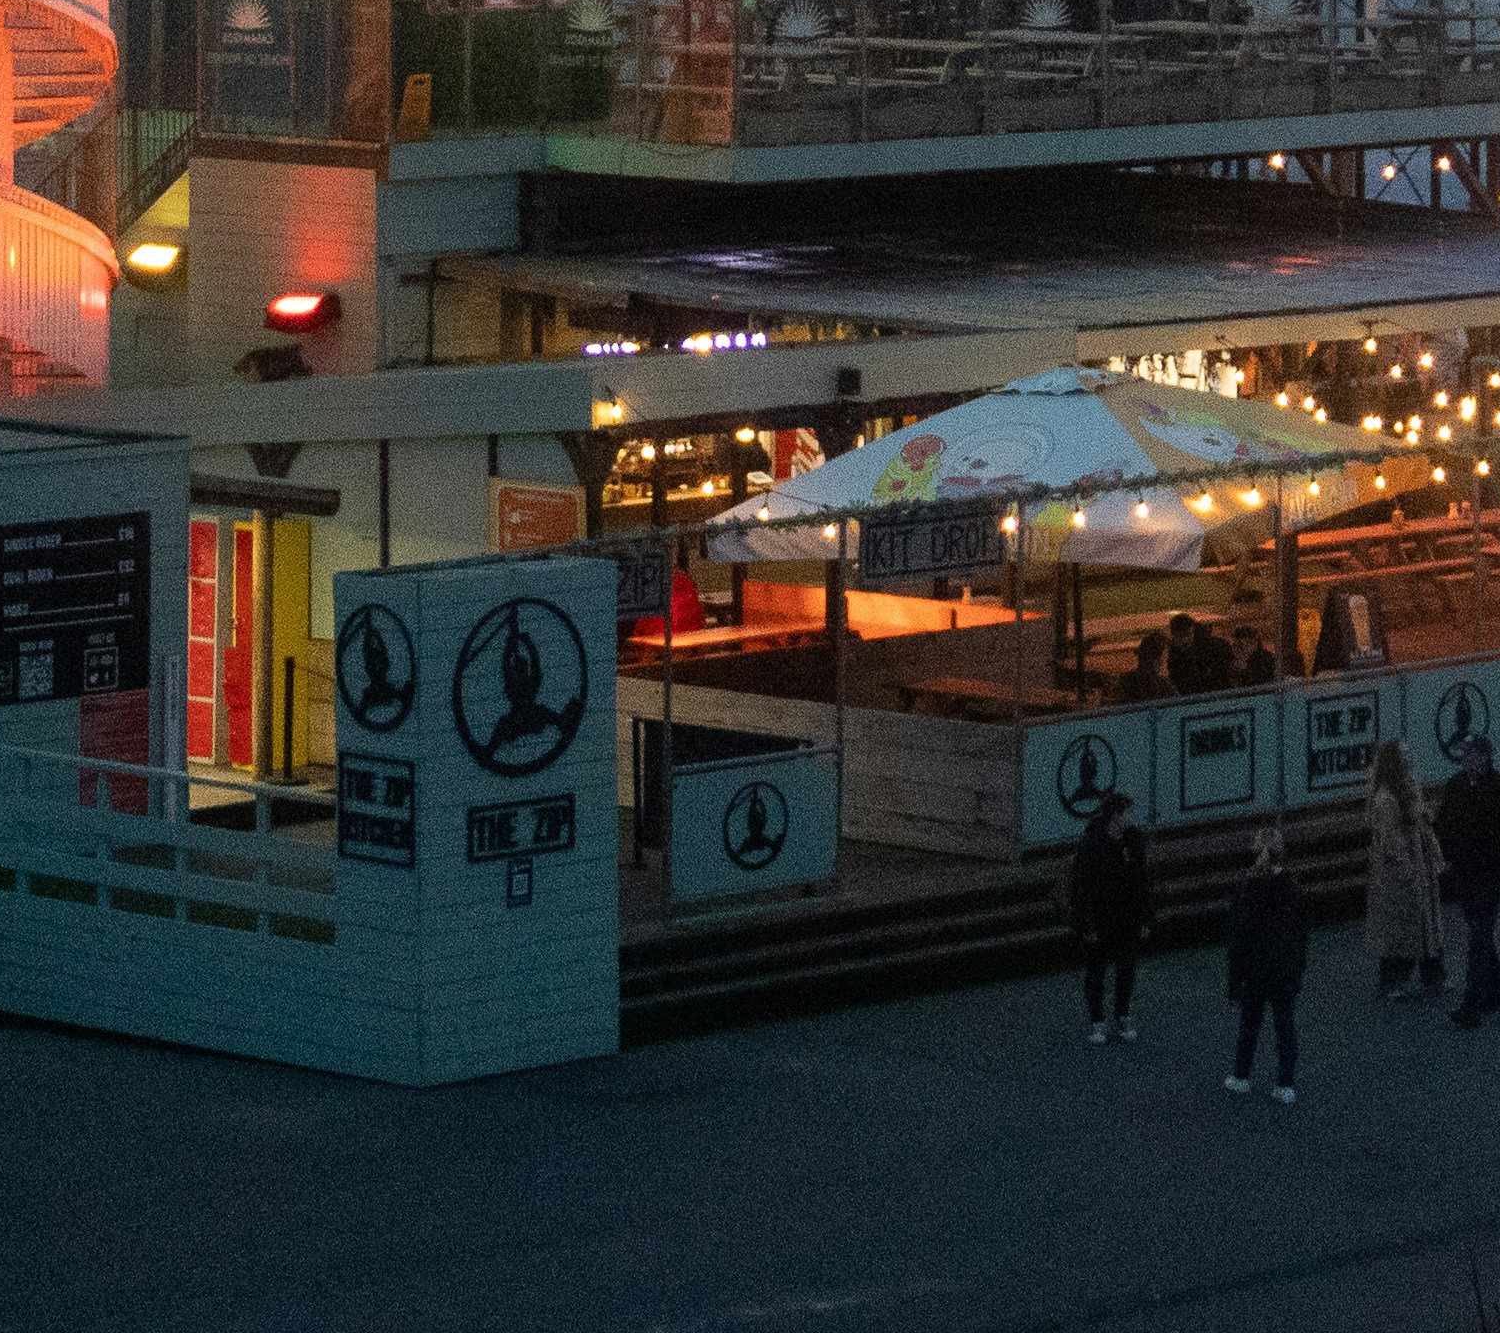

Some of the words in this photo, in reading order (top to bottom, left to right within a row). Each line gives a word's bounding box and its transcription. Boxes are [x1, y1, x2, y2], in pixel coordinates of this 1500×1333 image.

[872, 527, 914, 570] KIT
[1315, 710, 1343, 739] THE
[1348, 706, 1372, 733] ZIP
[471, 811, 518, 852] THE
[533, 805, 571, 845] ZIP
